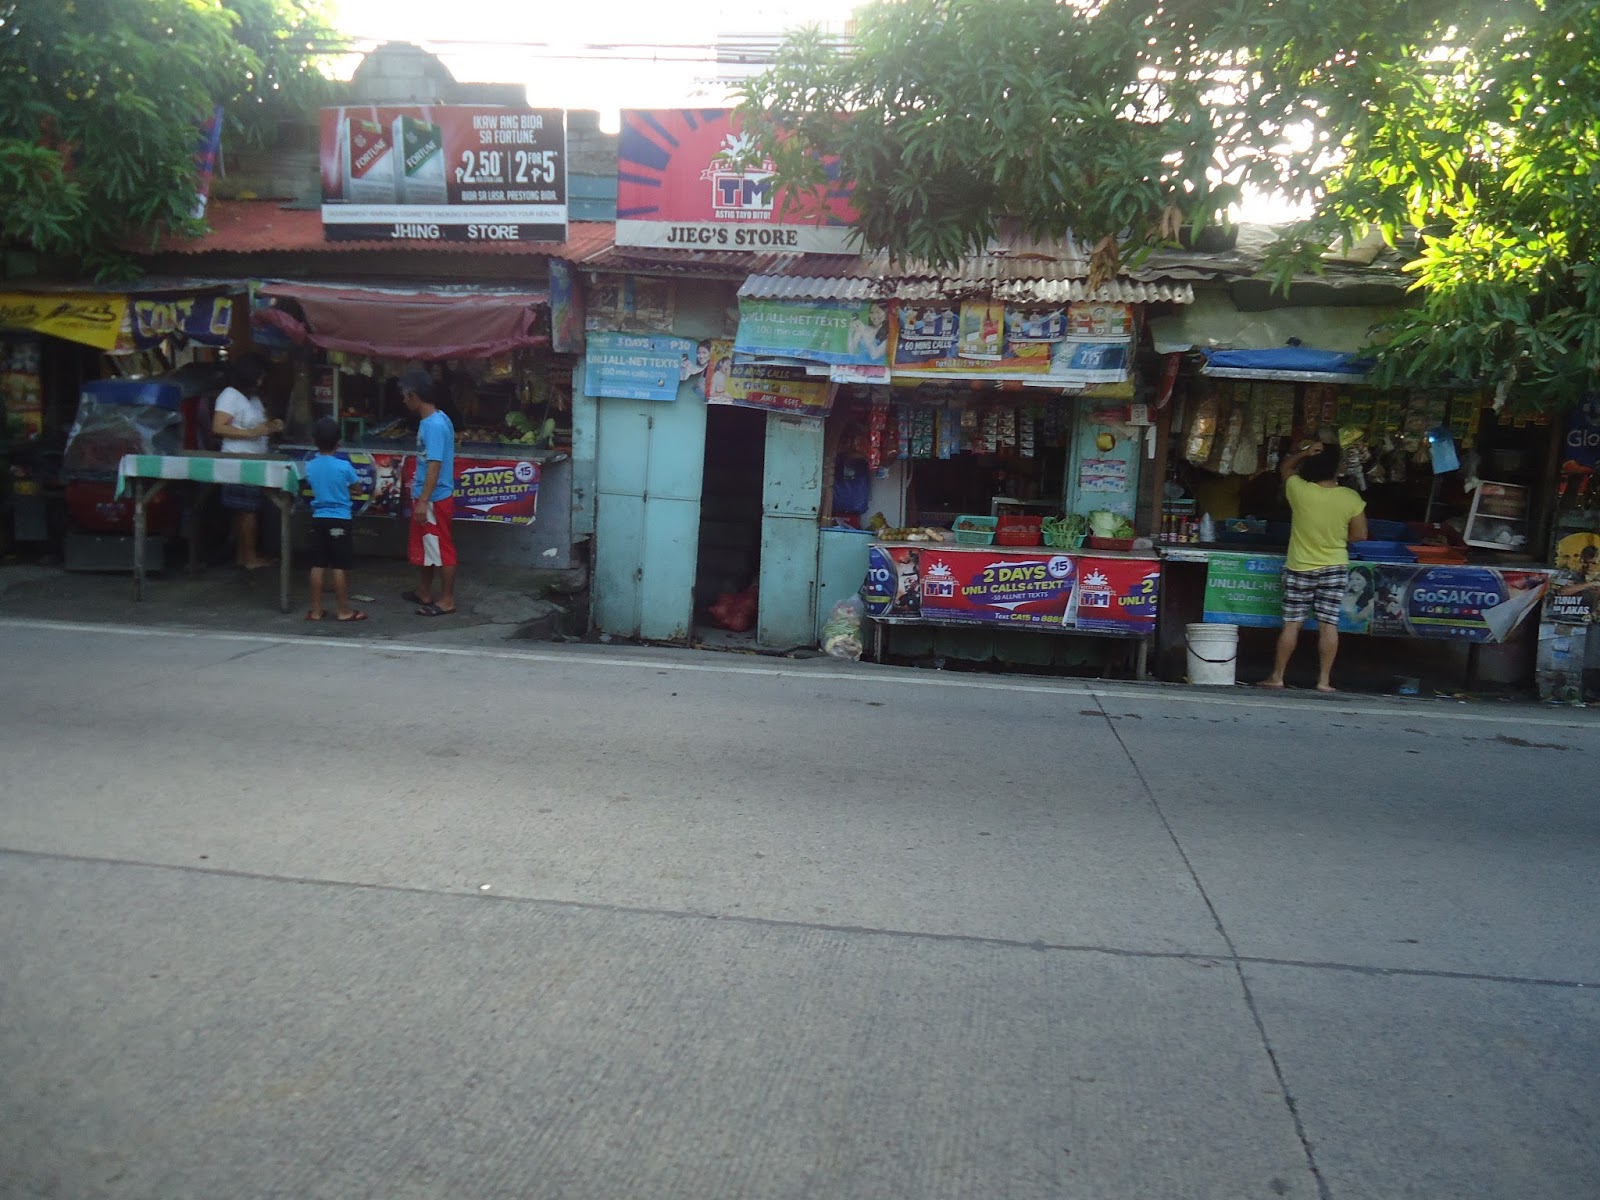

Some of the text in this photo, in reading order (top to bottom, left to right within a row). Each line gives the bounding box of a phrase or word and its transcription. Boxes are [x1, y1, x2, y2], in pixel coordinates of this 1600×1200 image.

[473, 115, 543, 129] IKAW ANG BIDA
[480, 130, 537, 144] SA FORTUNE.
[355, 137, 387, 170] FORTUNE
[406, 141, 438, 169] FORTUNE
[718, 178, 774, 207] TM
[391, 223, 519, 239] JHING STORE
[667, 226, 799, 247] JIEG'S STORE
[460, 474, 471, 487] 2
[474, 470, 515, 486] DAYS
[1248, 560, 1257, 571] 3
[983, 569, 995, 584] 2
[999, 565, 1047, 582] DAYS
[961, 584, 988, 596] UNLI
[1142, 579, 1154, 594] 2
[1208, 577, 1280, 592] UNLI ALL-NE
[1028, 591, 1049, 600] TEXTS
[1117, 596, 1145, 607] UNLI
[1413, 587, 1500, 607] GoSAKTO
[994, 612, 1010, 621] Text
[1560, 605, 1590, 615] LAKAS
